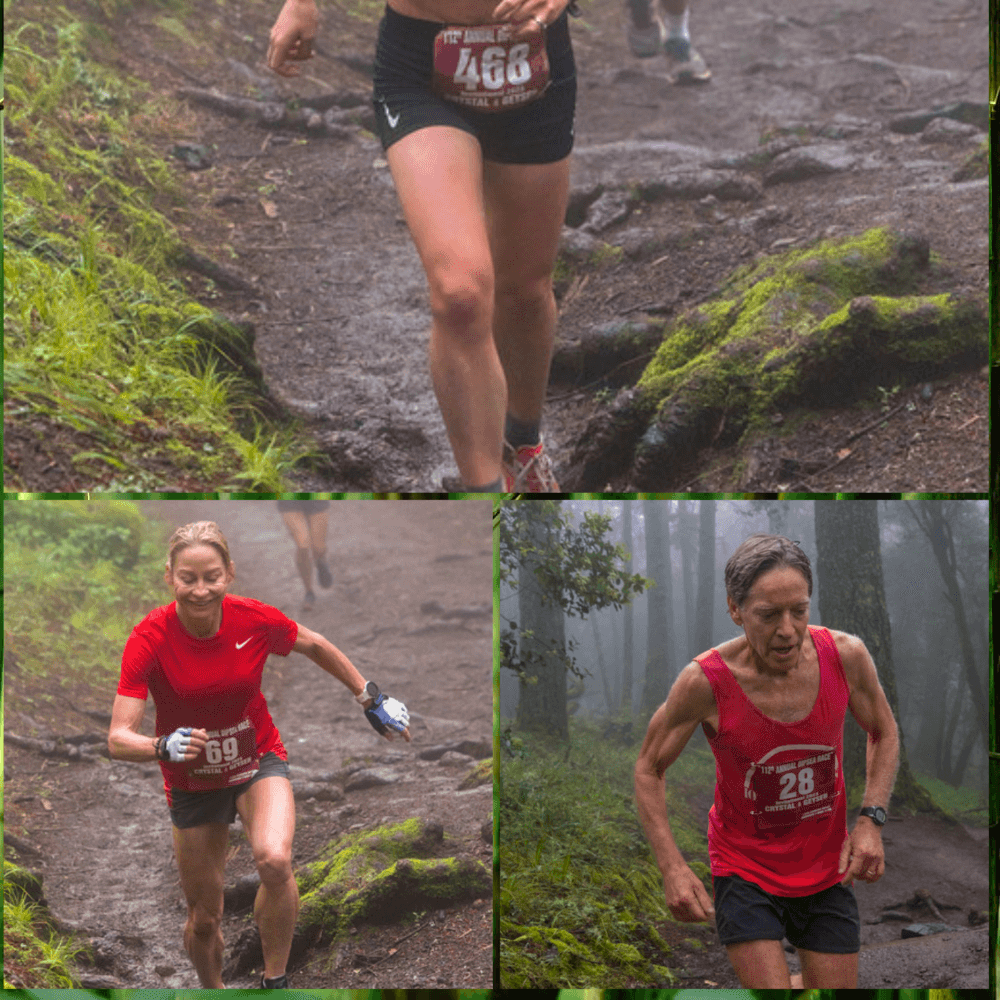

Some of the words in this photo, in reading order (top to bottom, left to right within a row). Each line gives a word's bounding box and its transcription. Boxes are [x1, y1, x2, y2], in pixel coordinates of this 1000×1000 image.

[453, 43, 532, 91] 468
[206, 737, 239, 764] 69
[775, 762, 797, 774] ANNUAL
[779, 767, 815, 800] 28
[764, 803, 795, 812] CRYSTAL
[803, 793, 829, 806] GEYSER
